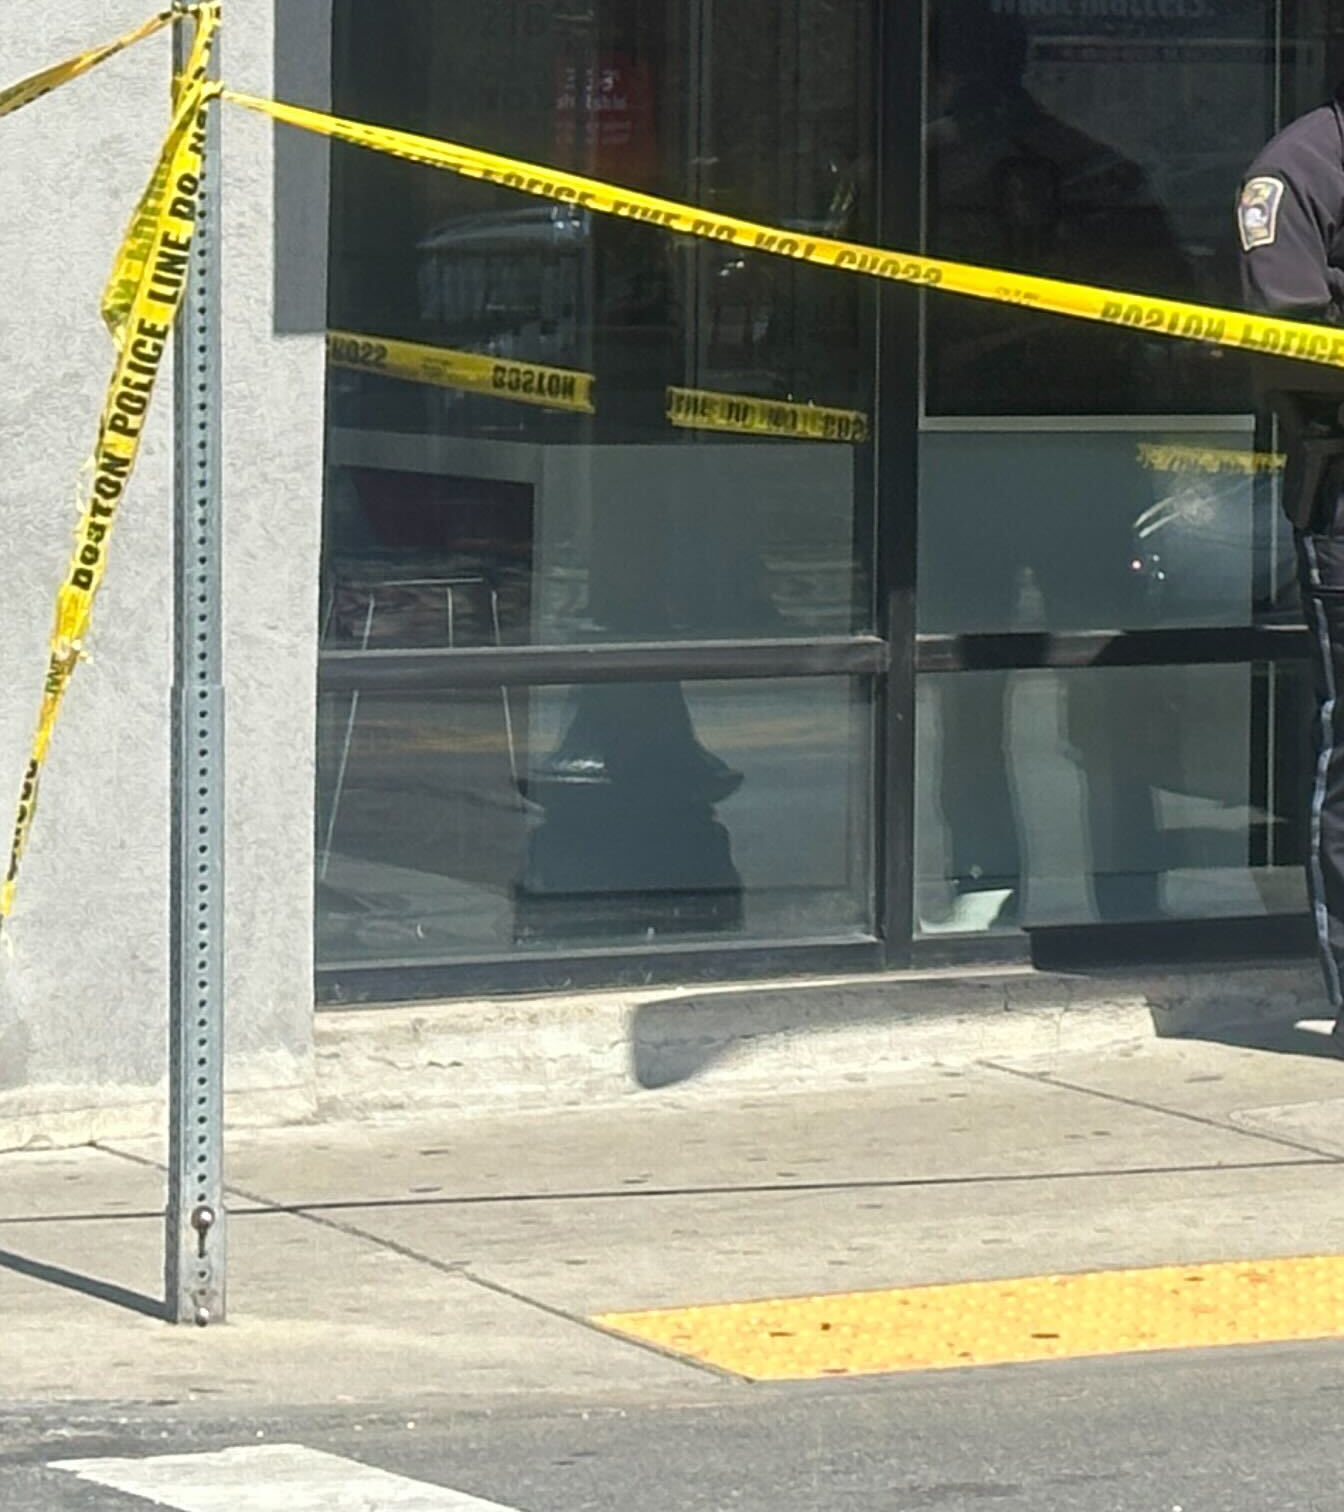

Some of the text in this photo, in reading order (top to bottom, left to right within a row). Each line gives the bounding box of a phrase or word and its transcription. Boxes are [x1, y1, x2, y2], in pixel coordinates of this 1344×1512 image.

[168, 172, 199, 222] DO
[146, 230, 192, 306] LINE
[107, 317, 170, 439] POLICE
[72, 452, 131, 590] BOSTON
